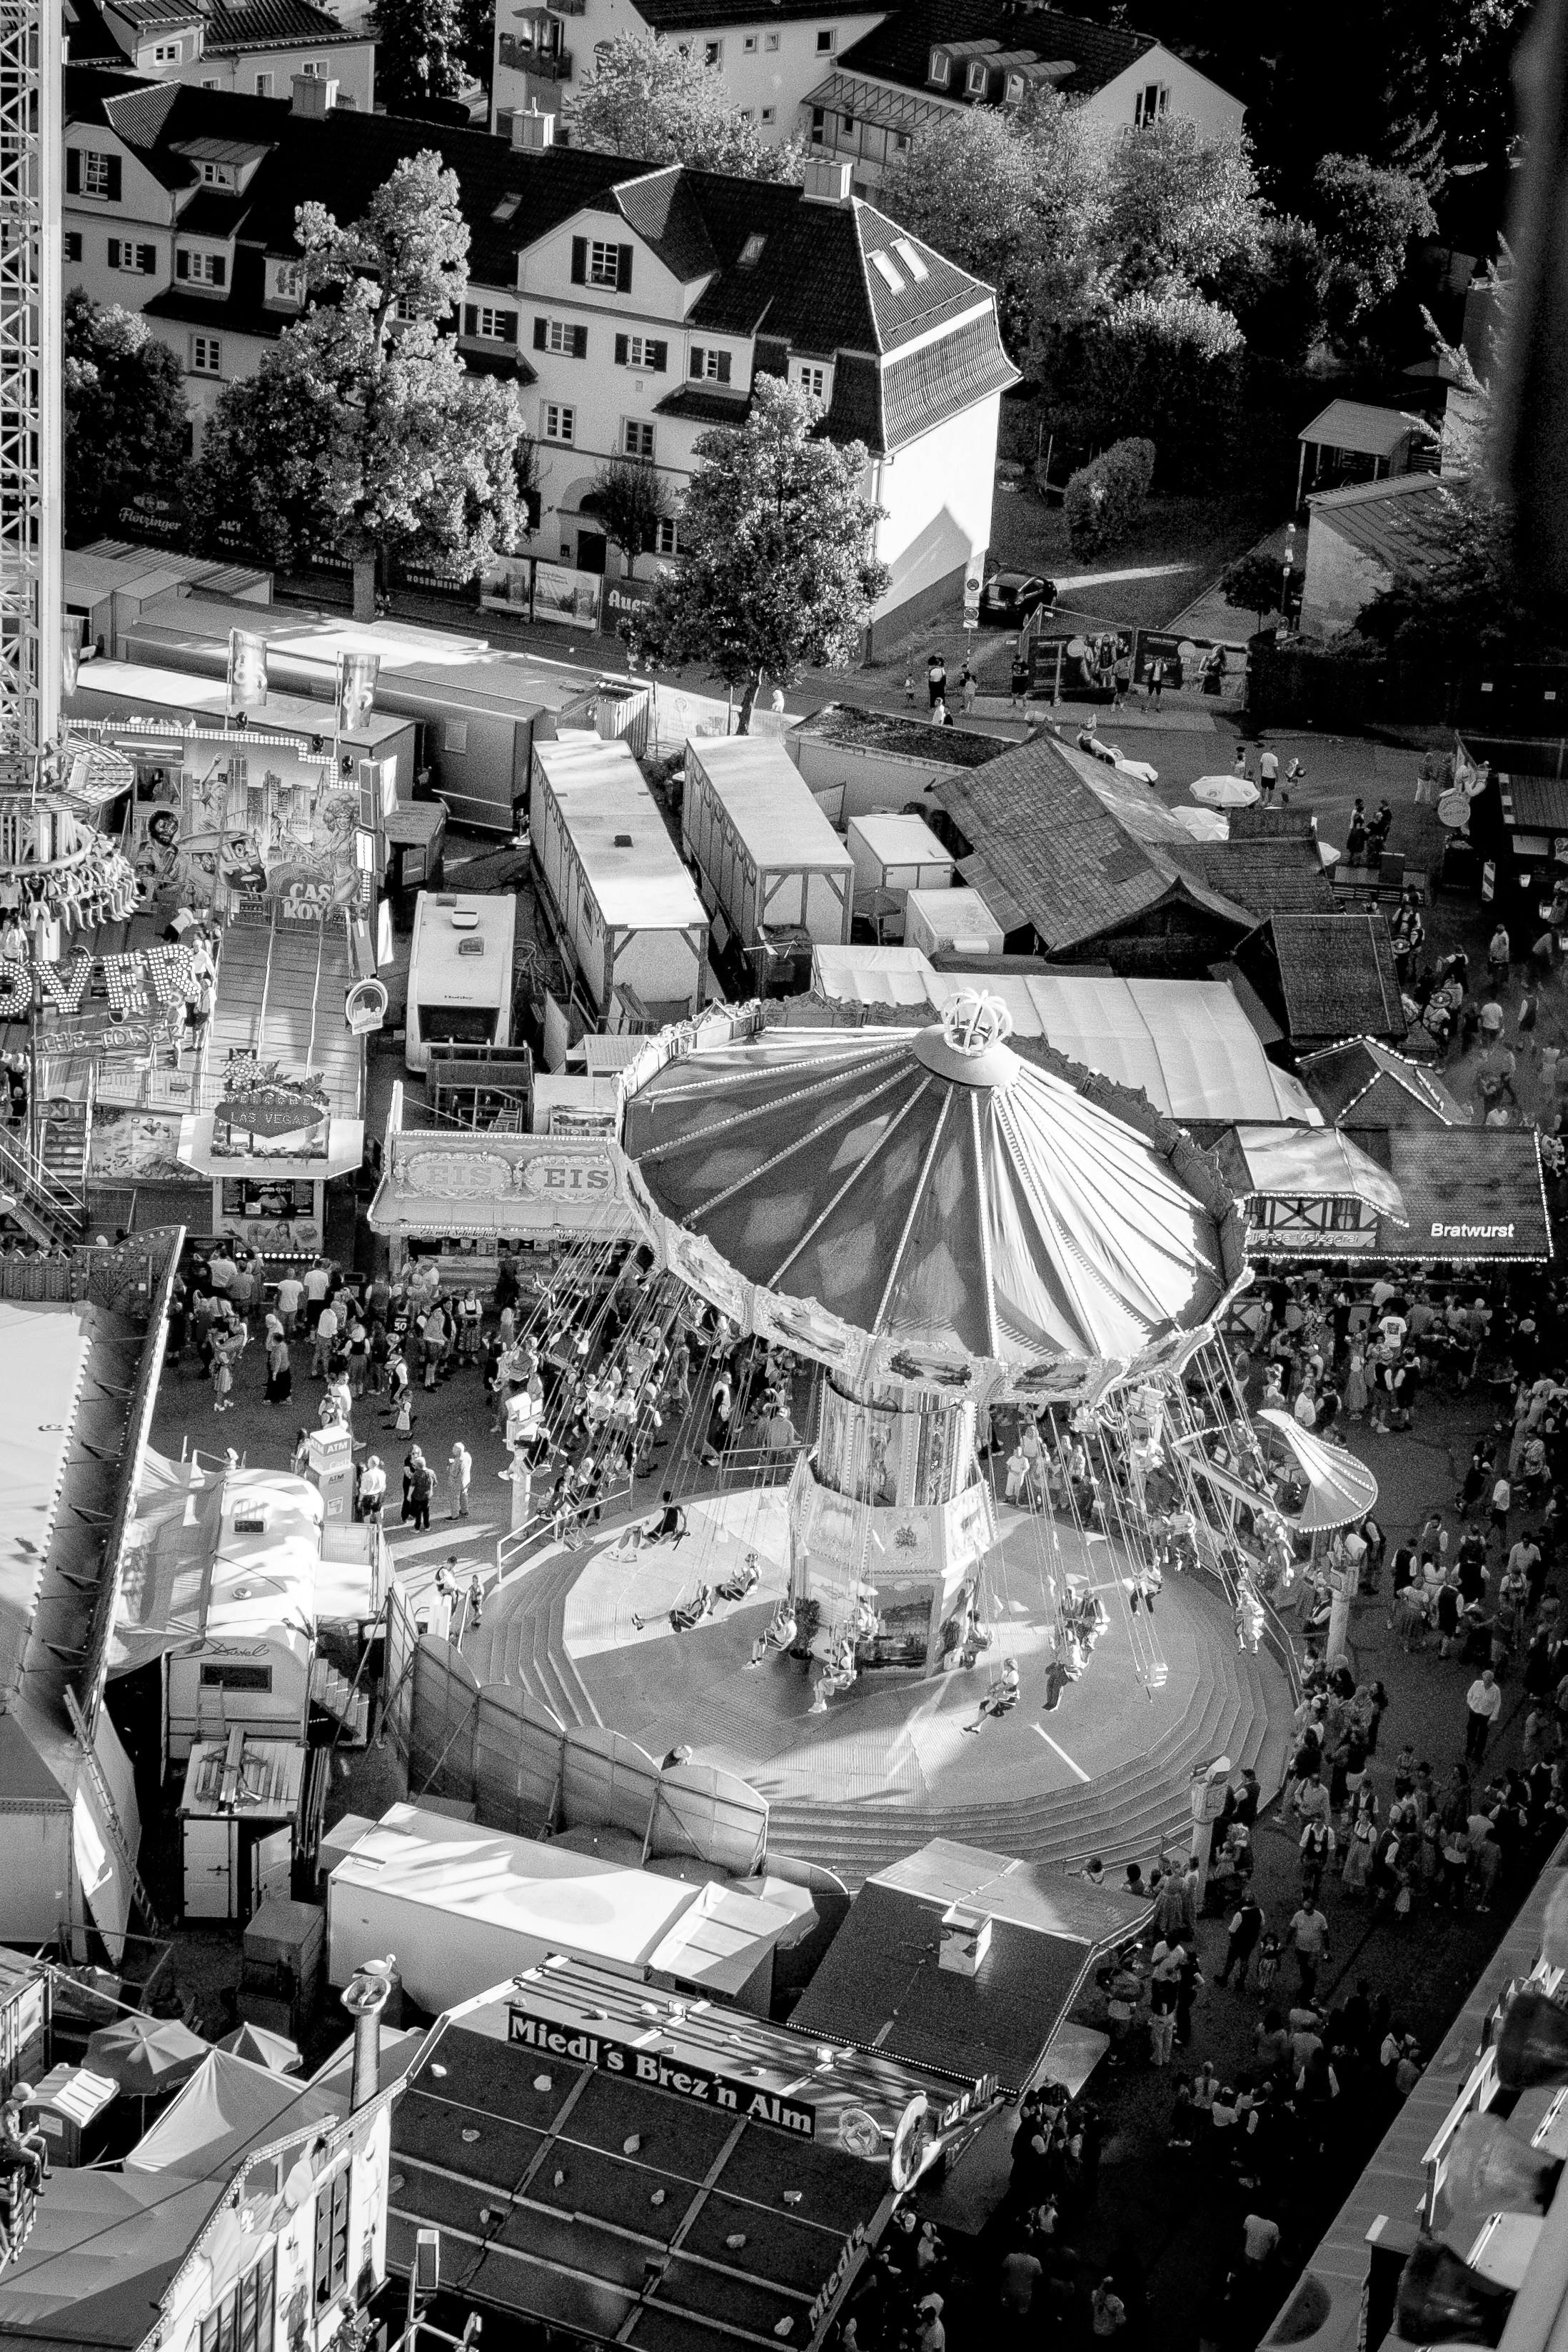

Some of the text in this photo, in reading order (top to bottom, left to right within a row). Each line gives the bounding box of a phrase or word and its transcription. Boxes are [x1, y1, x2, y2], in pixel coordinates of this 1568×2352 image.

[119, 507, 181, 531] Flötzinger
[36, 1030, 88, 1053] THE
[226, 1093, 311, 1106] WELCOME
[37, 1103, 84, 1118] EXIT
[231, 1112, 311, 1125] LAS VEGAS
[426, 1165, 492, 1186] EIS
[544, 1167, 609, 1189] EIS
[1431, 1222, 1514, 1238] Bratwurst
[1295, 1232, 1359, 1245] Metzgerei
[327, 1440, 348, 1454] ATM
[328, 1474, 344, 1483] ATM
[746, 2093, 813, 2134] Alm
